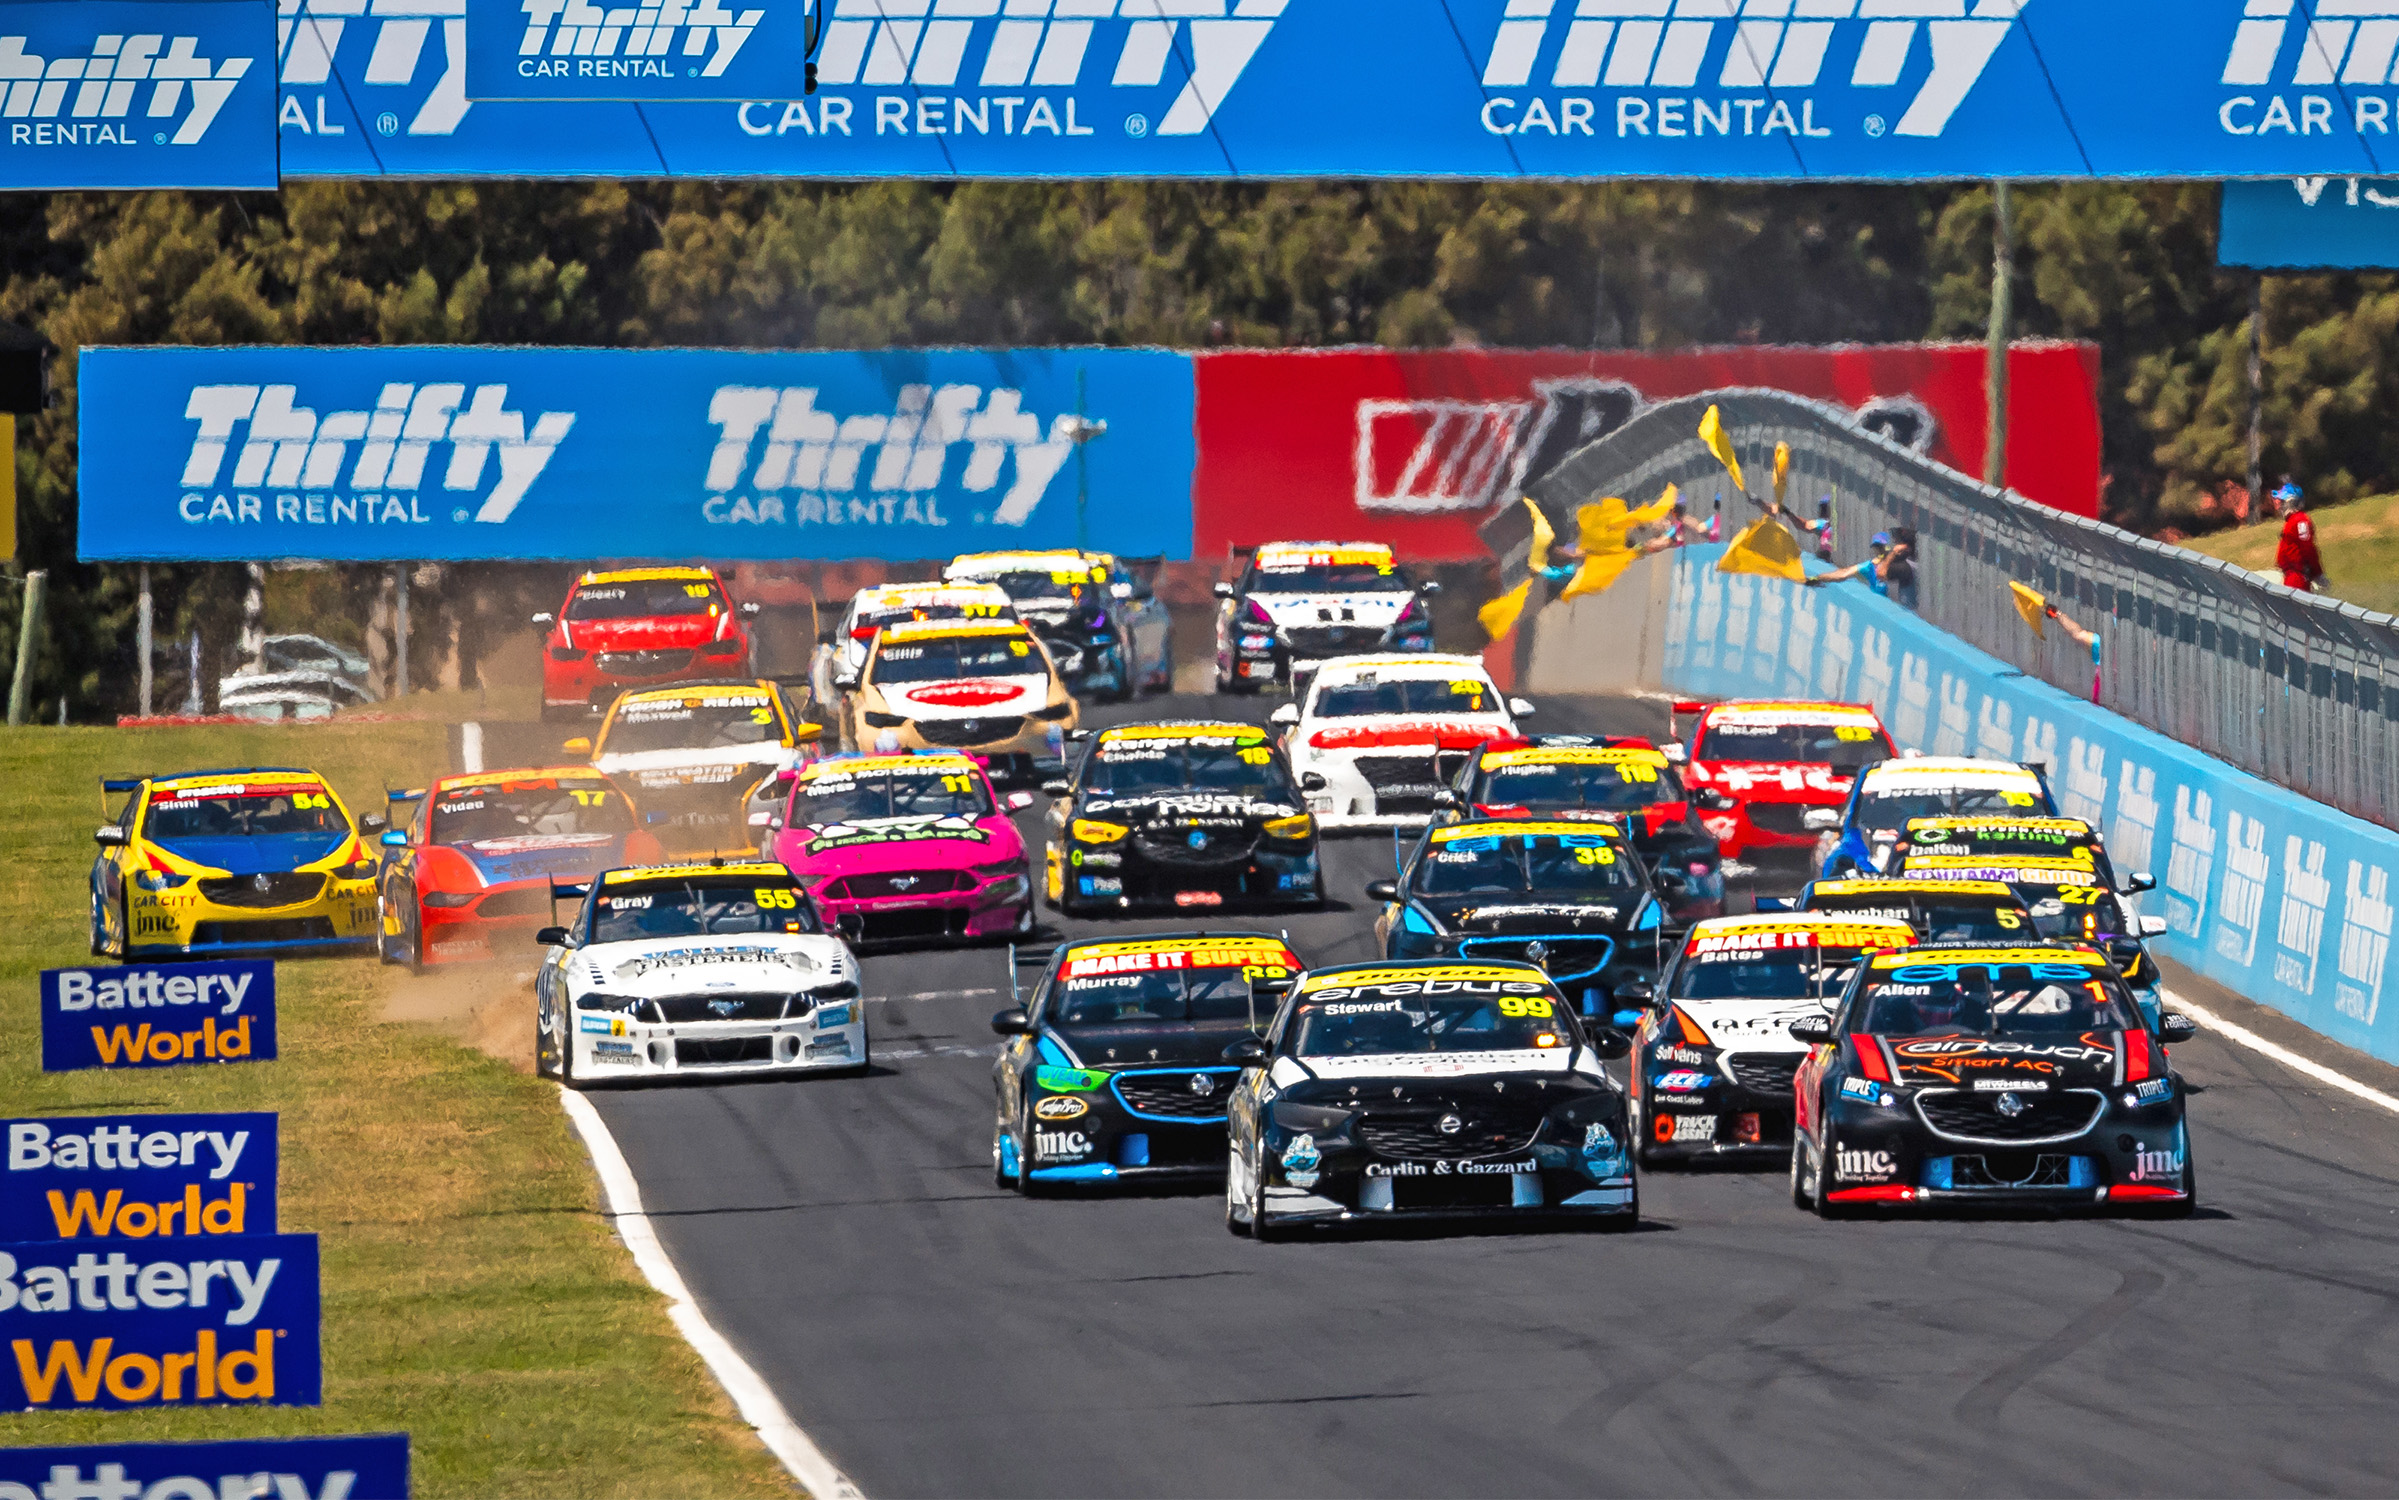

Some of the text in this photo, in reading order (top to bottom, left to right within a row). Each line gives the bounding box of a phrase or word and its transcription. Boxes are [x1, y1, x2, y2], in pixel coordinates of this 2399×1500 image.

[517, 60, 675, 78] CAR RENTAL
[738, 96, 1094, 136] CAR RENTAL
[1481, 97, 1831, 138] CAR RENTAL
[2220, 96, 2333, 137] CAR
[12, 123, 137, 145] RENTAL
[179, 382, 577, 523] Thrifty
[704, 384, 1078, 526] Thrifty
[178, 494, 431, 524] CAR RENTAL
[703, 495, 947, 526] CAR RENTAL
[750, 707, 772, 725] 3
[941, 774, 974, 793] 11
[292, 792, 331, 810] 54
[568, 789, 606, 807] 17
[1574, 846, 1616, 866] 38
[161, 894, 198, 908] CITY
[611, 894, 653, 911] Gray
[754, 888, 796, 909] 55
[2057, 884, 2101, 905] 27
[1996, 908, 2021, 930] 5
[1697, 932, 1909, 952] MAKE IT SUPER
[1070, 950, 1287, 975] MAKE IT SUPER
[1701, 949, 1764, 963] Bates
[58, 971, 253, 1015] Battery
[1067, 975, 1143, 992] Murray
[1309, 980, 1543, 1002] erebus
[1875, 983, 1931, 998] Allen
[2084, 981, 2108, 1002] 1
[1325, 999, 1403, 1016] Stewart
[1498, 997, 1554, 1018] 99
[92, 1016, 251, 1063] World
[1907, 1040, 2115, 1064] airtouch
[1931, 1056, 2055, 1074] Smart AC
[8, 1123, 250, 1179] Battery
[1365, 1158, 1538, 1177] Carlin & Gazzard
[46, 1182, 246, 1238] World
[11, 1329, 275, 1403] World
